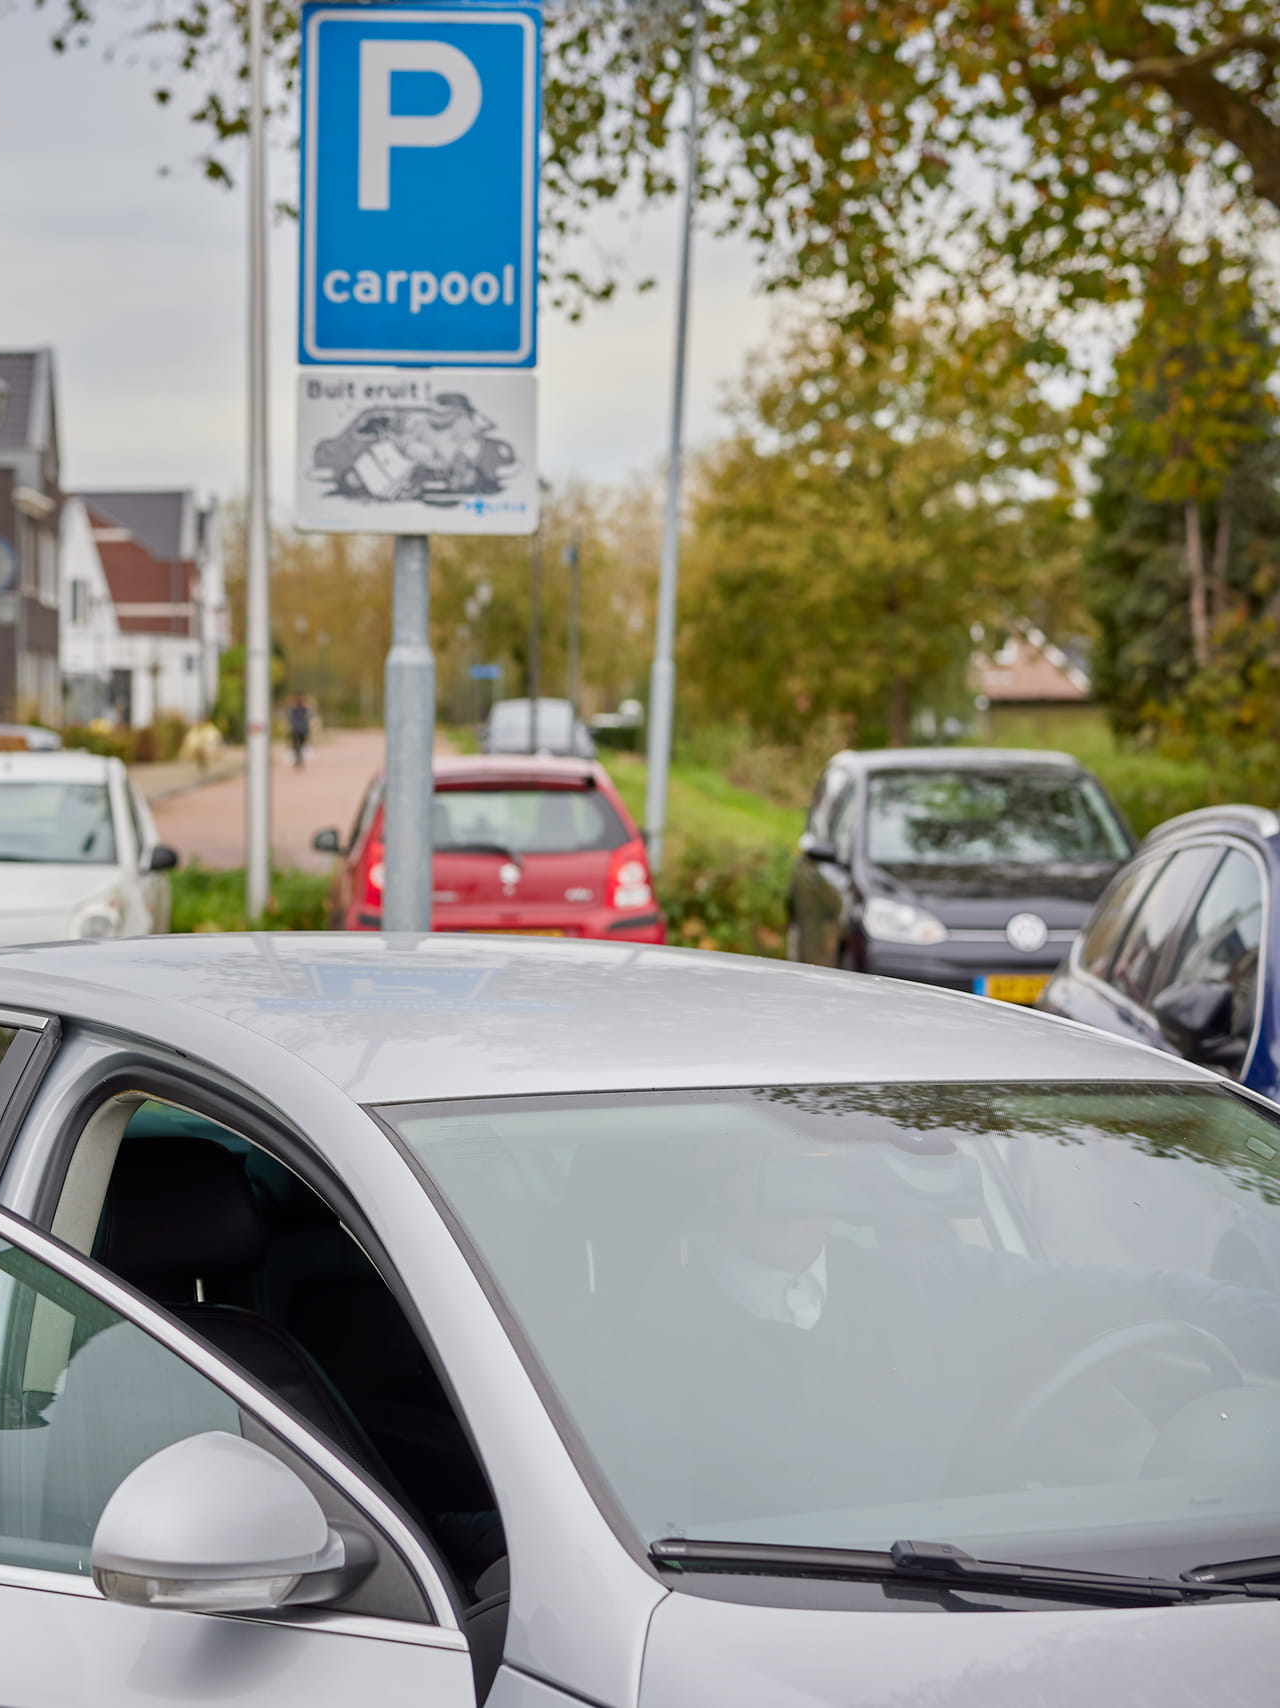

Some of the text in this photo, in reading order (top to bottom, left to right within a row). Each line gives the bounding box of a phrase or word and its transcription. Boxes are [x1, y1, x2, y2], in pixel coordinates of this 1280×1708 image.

[358, 39, 483, 211] P
[323, 263, 515, 314] carpool
[306, 380, 354, 399] Buit
